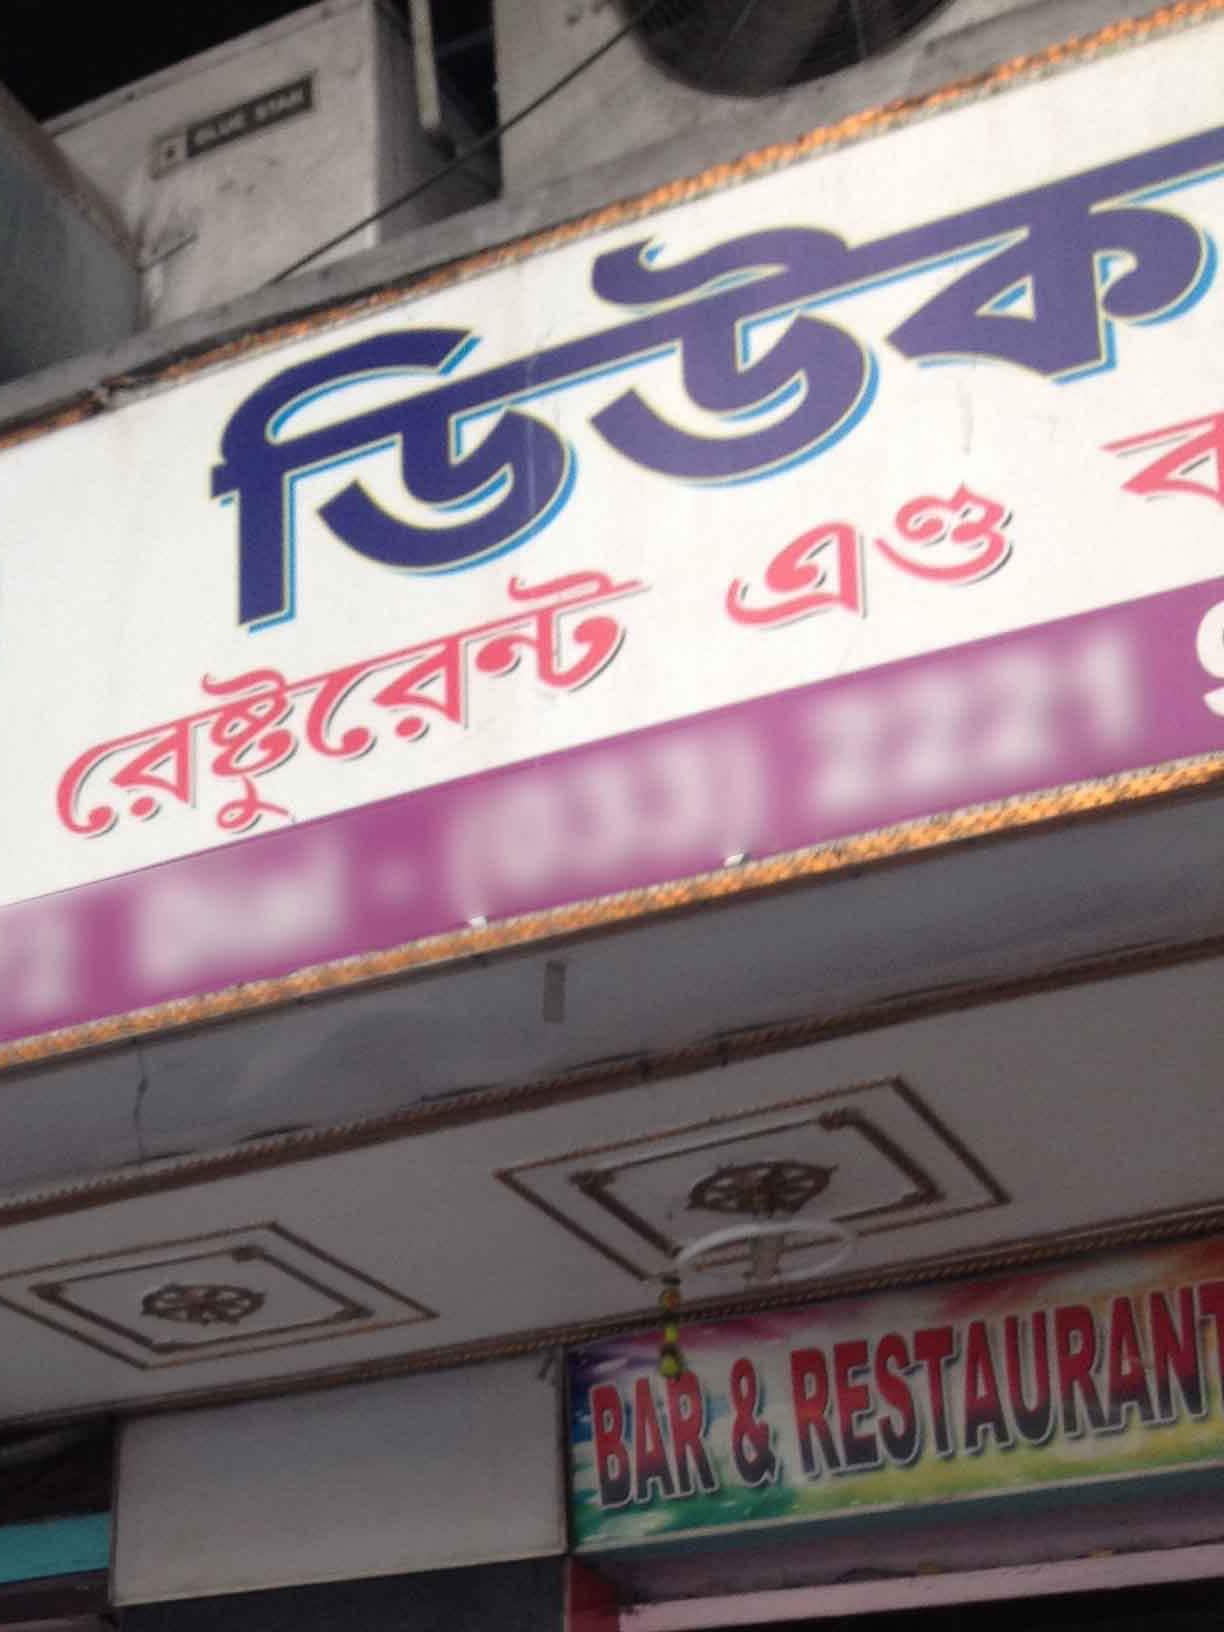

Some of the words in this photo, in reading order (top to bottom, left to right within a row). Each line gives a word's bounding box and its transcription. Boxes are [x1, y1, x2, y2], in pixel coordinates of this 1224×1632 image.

[212, 124, 1224, 632] ডিউক
[590, 1368, 718, 1510] BAR
[730, 1356, 780, 1489] &
